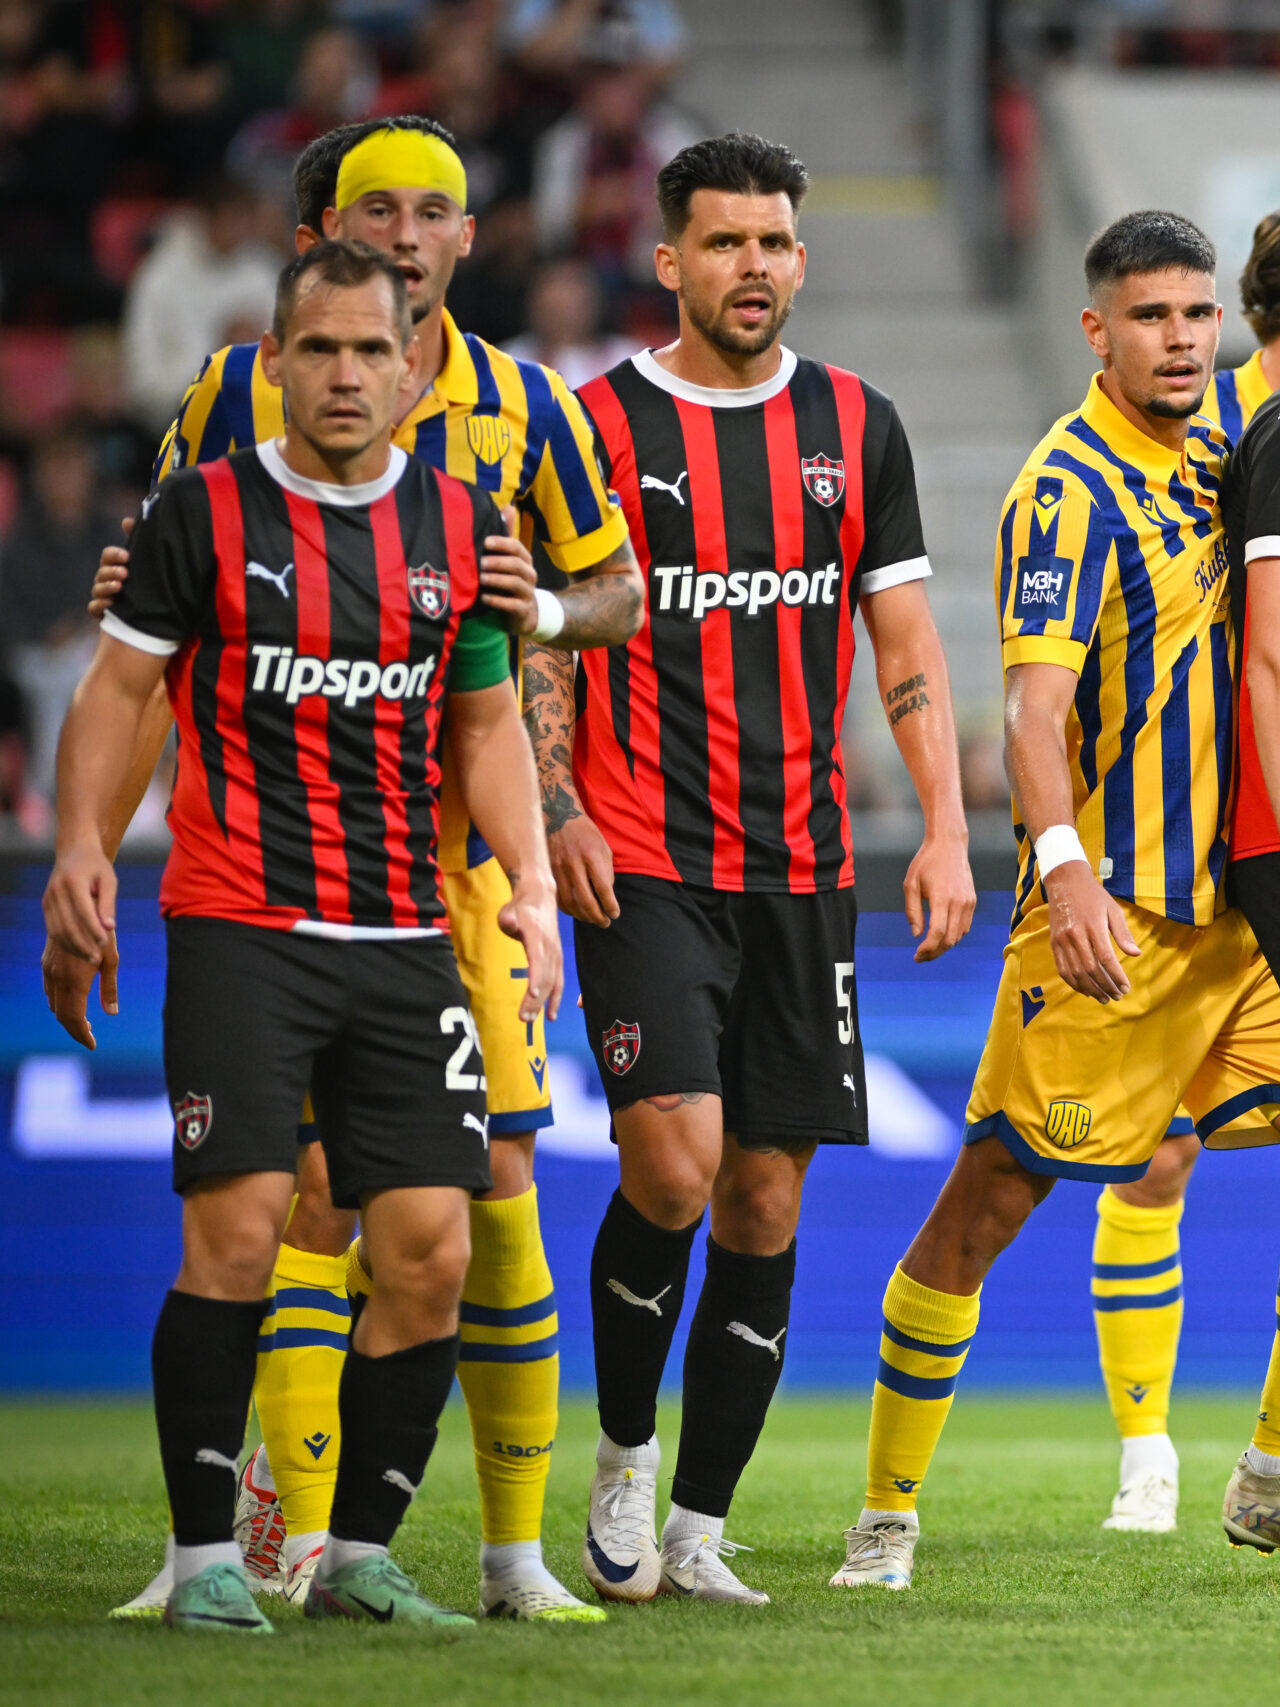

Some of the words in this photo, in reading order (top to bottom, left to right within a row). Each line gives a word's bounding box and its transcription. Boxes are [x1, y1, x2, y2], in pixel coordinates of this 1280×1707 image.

[654, 562, 840, 619] Tipsport
[1021, 590, 1060, 606] BANK
[1022, 570, 1064, 591] MBH
[252, 644, 436, 707] Tipsport
